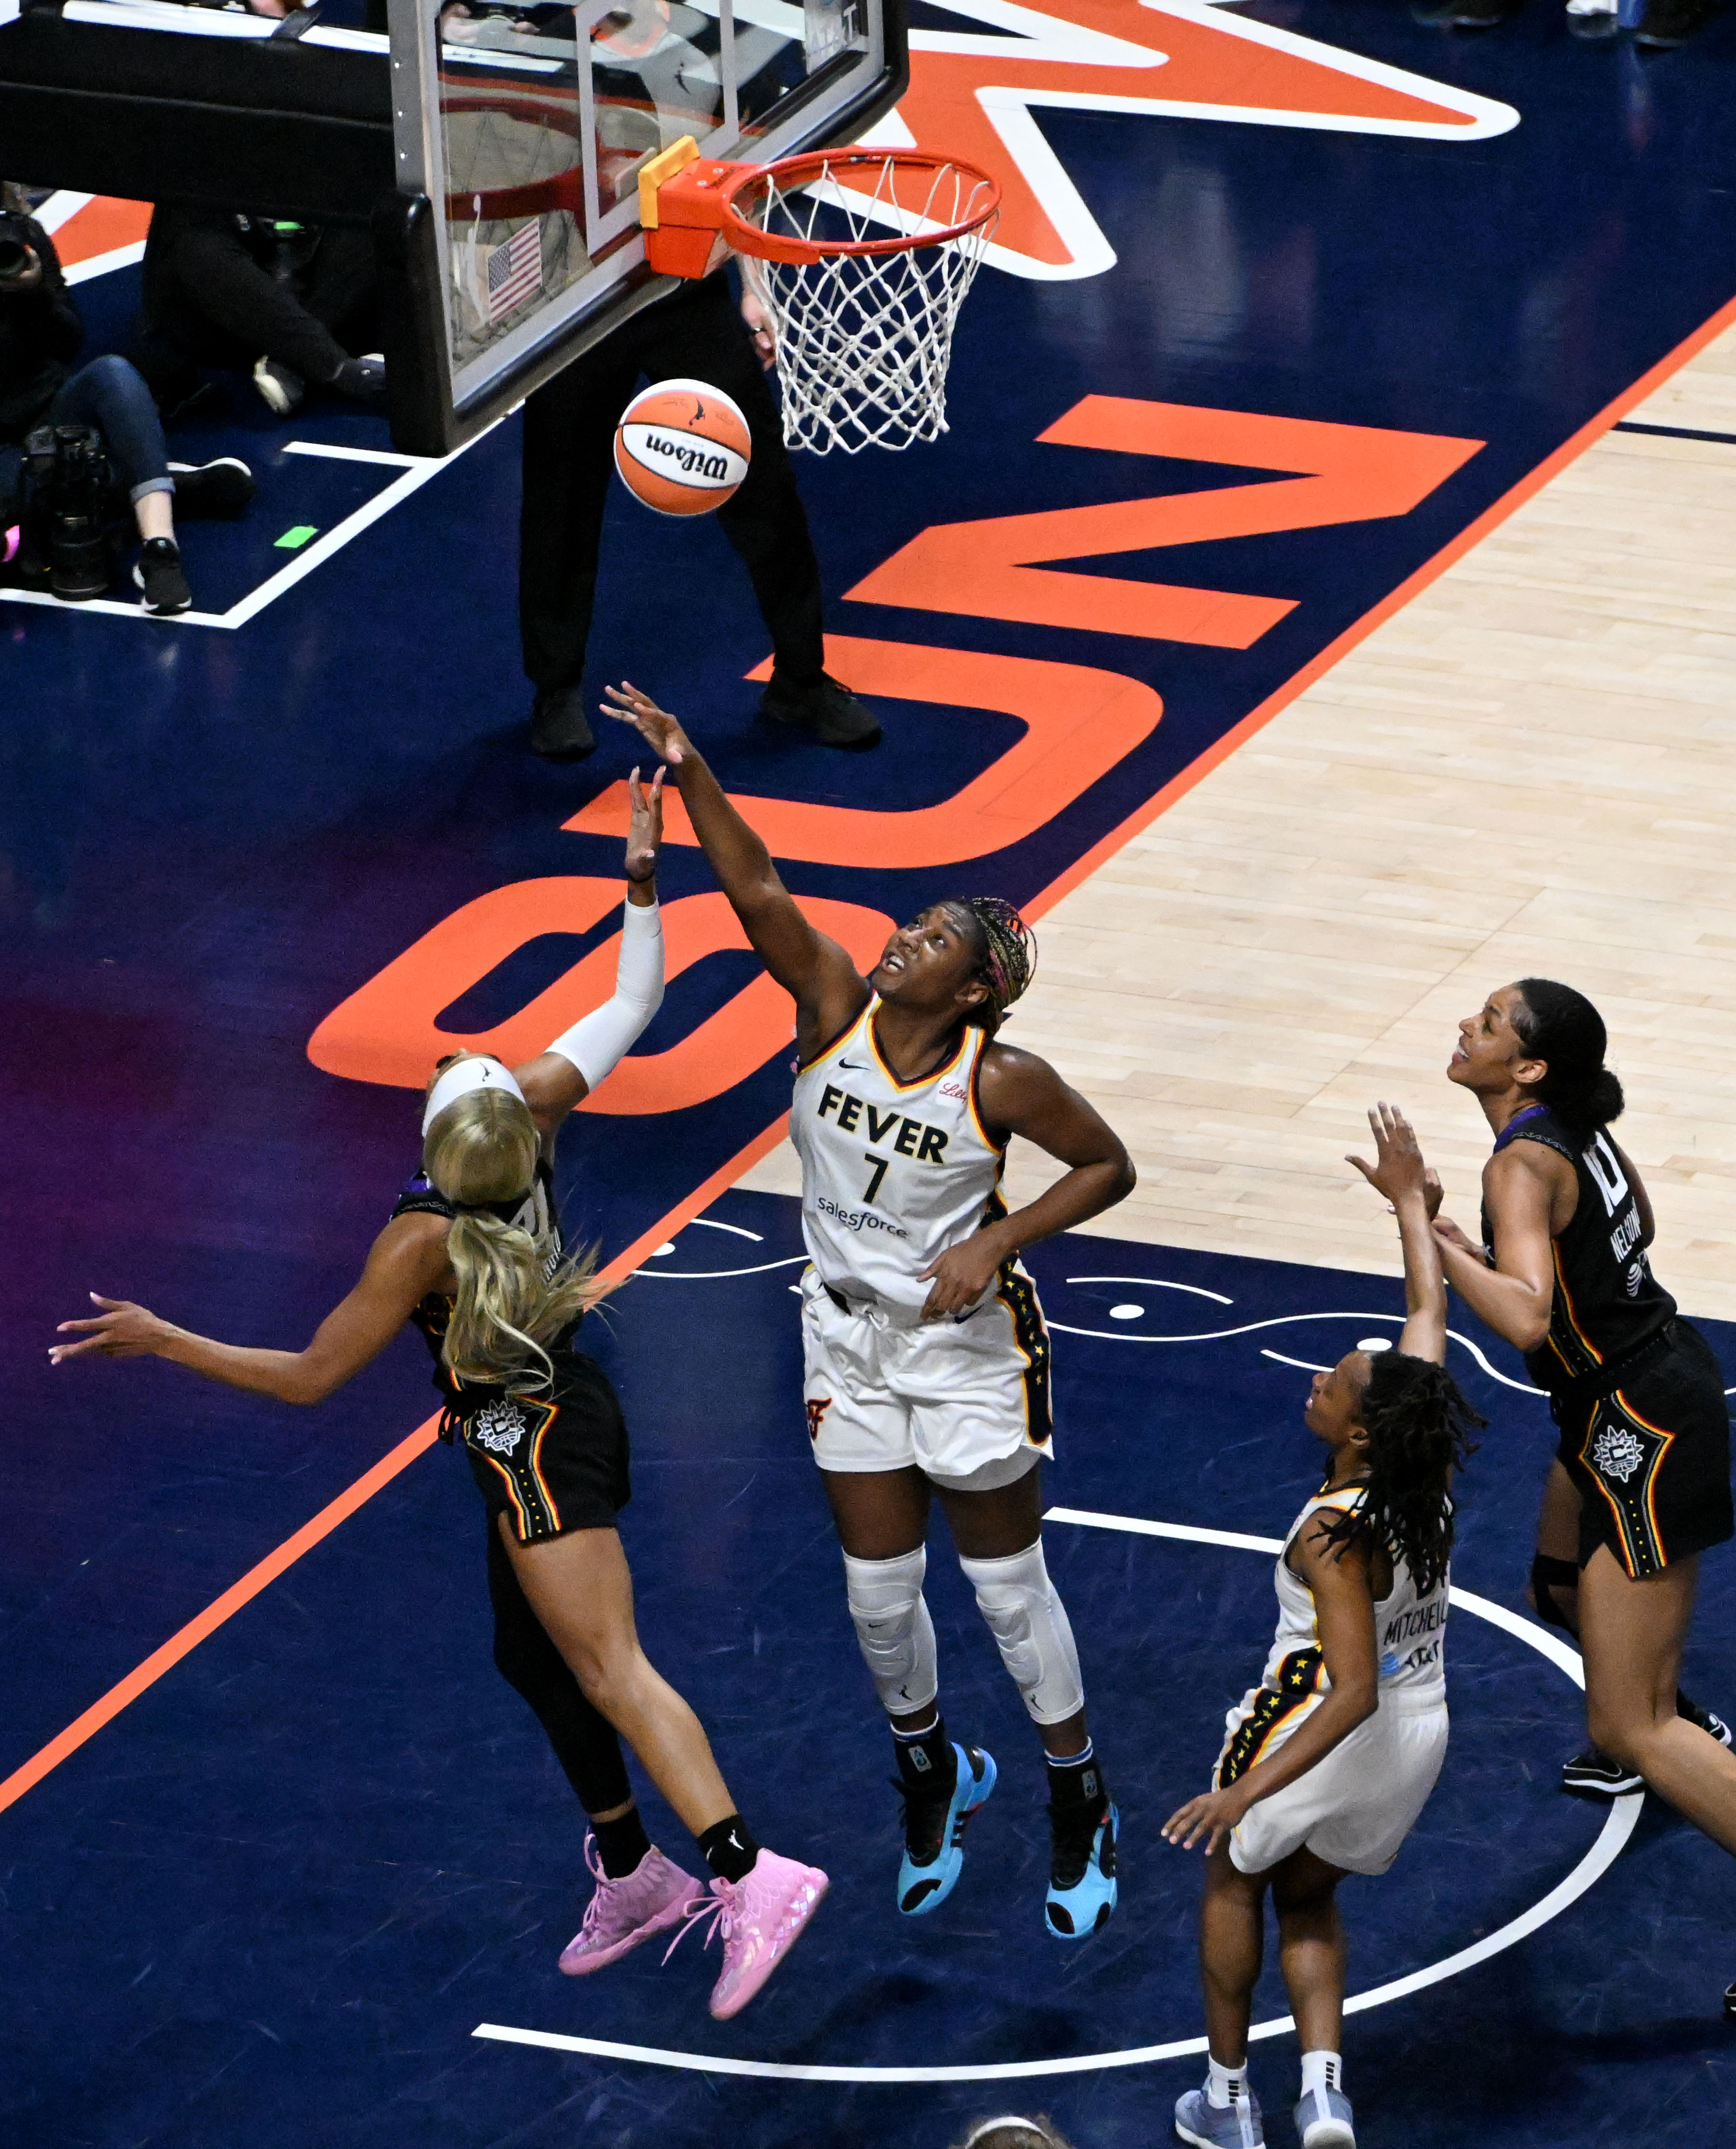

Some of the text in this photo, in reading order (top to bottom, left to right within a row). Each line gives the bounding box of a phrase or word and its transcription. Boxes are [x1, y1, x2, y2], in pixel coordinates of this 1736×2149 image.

[646, 433, 728, 480] Wilson
[939, 1083, 967, 1104] Lilly
[817, 1083, 949, 1164] FEVER
[863, 1152, 890, 1204] 7
[818, 1197, 907, 1240] salesforce
